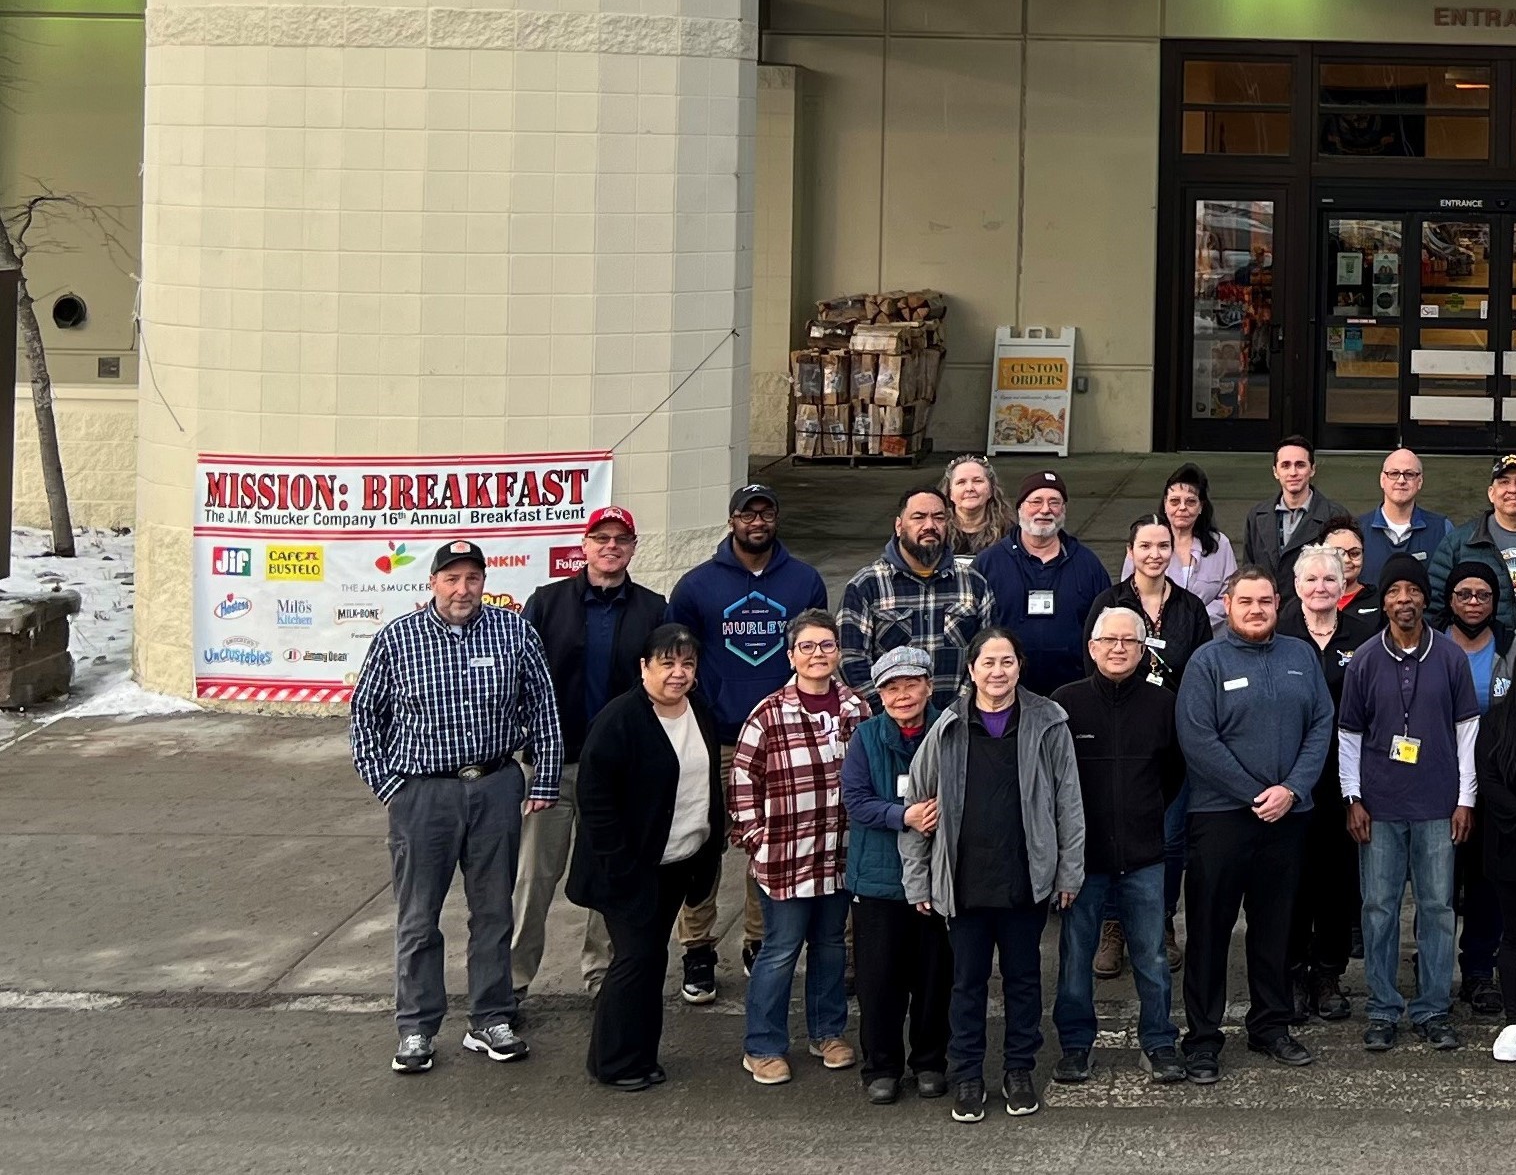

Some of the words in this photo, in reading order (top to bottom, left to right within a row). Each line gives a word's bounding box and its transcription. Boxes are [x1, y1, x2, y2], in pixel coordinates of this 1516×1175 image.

[1440, 199, 1483, 208] ENTRANCE
[1010, 363, 1064, 374] CUSTOM
[1010, 375, 1063, 385] ORDERS
[204, 472, 349, 511] MISSION:
[361, 469, 589, 511] BREAKFAST
[205, 510, 225, 523] The
[227, 511, 250, 524] J.M.
[254, 510, 307, 525] Smucker
[313, 512, 377, 528] Company
[381, 512, 407, 525] 16th
[411, 511, 461, 525] Annual
[470, 509, 541, 524] Breakfast
[545, 506, 586, 521] Event
[215, 550, 250, 574] Jif
[487, 555, 530, 567] NKIN'
[555, 559, 588, 571] Folge
[268, 564, 320, 575] BUSTELO
[341, 583, 359, 593] THE
[277, 612, 313, 625] Kitchen
[722, 621, 787, 635] HURLEY
